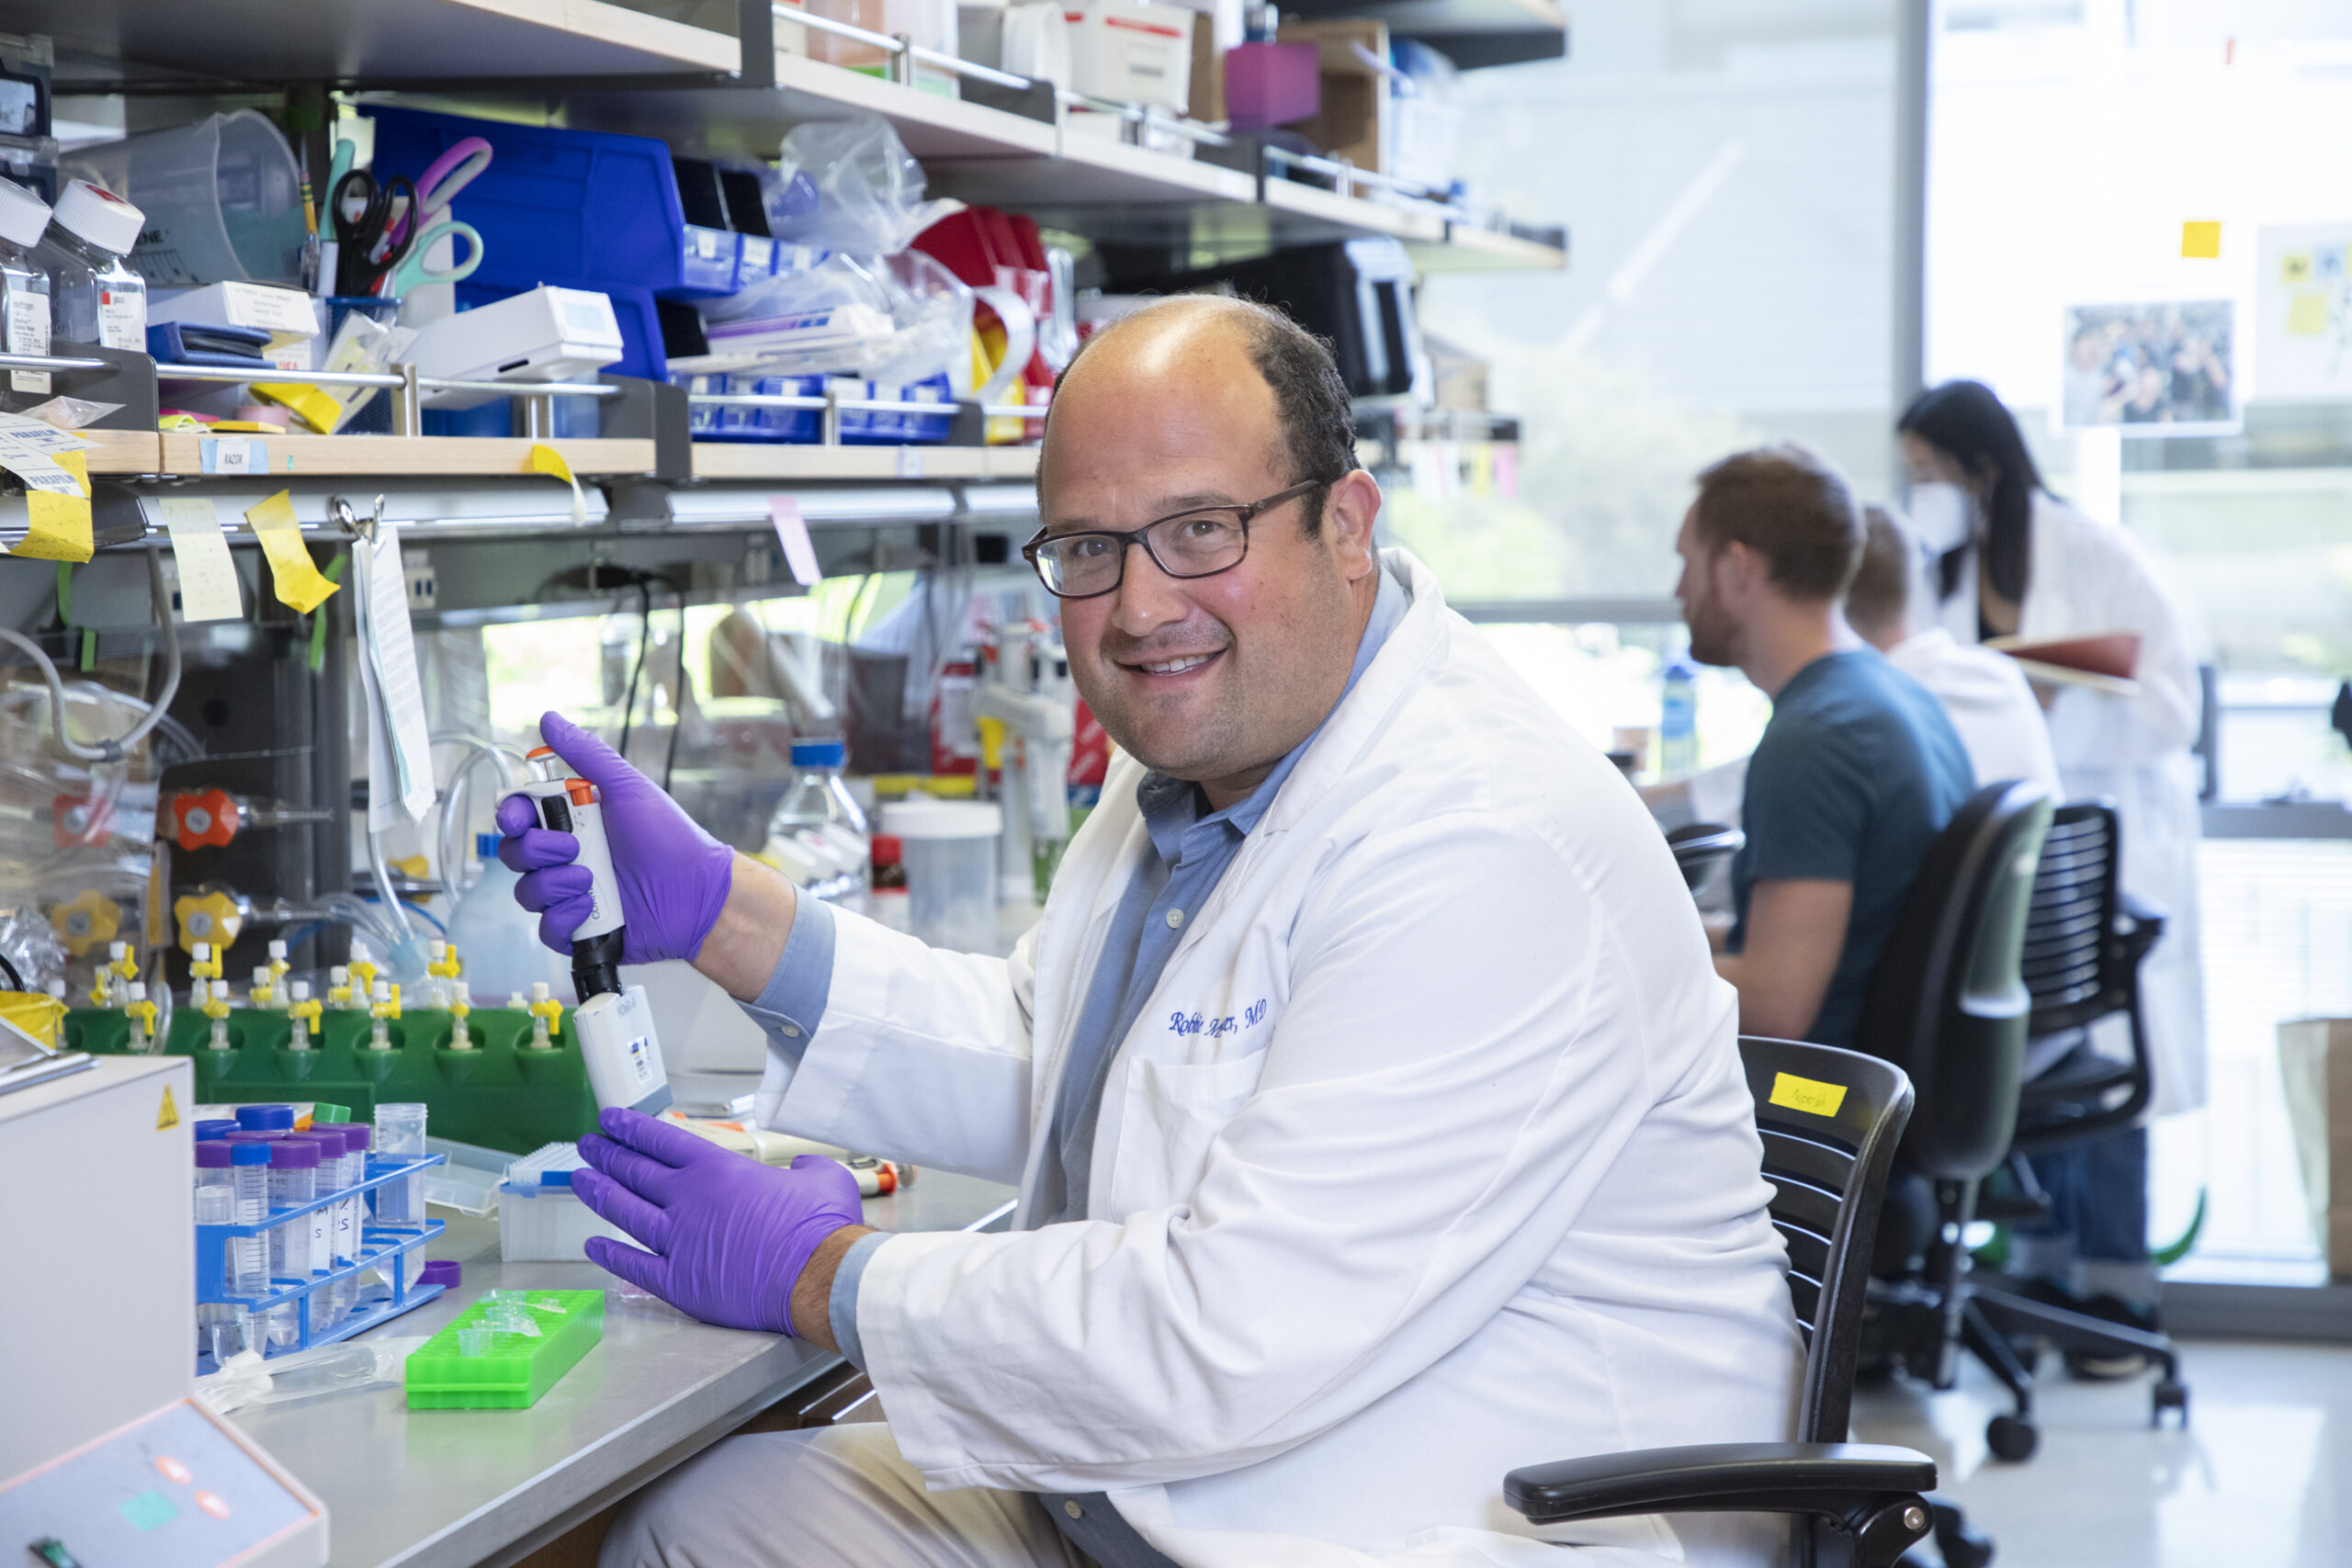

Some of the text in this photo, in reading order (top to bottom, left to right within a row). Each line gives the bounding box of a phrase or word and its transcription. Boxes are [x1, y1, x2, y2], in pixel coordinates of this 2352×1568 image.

[9, 429, 59, 438] PARAFILM
[28, 474, 77, 486] PARAFILM
[1245, 998, 1267, 1029] MD
